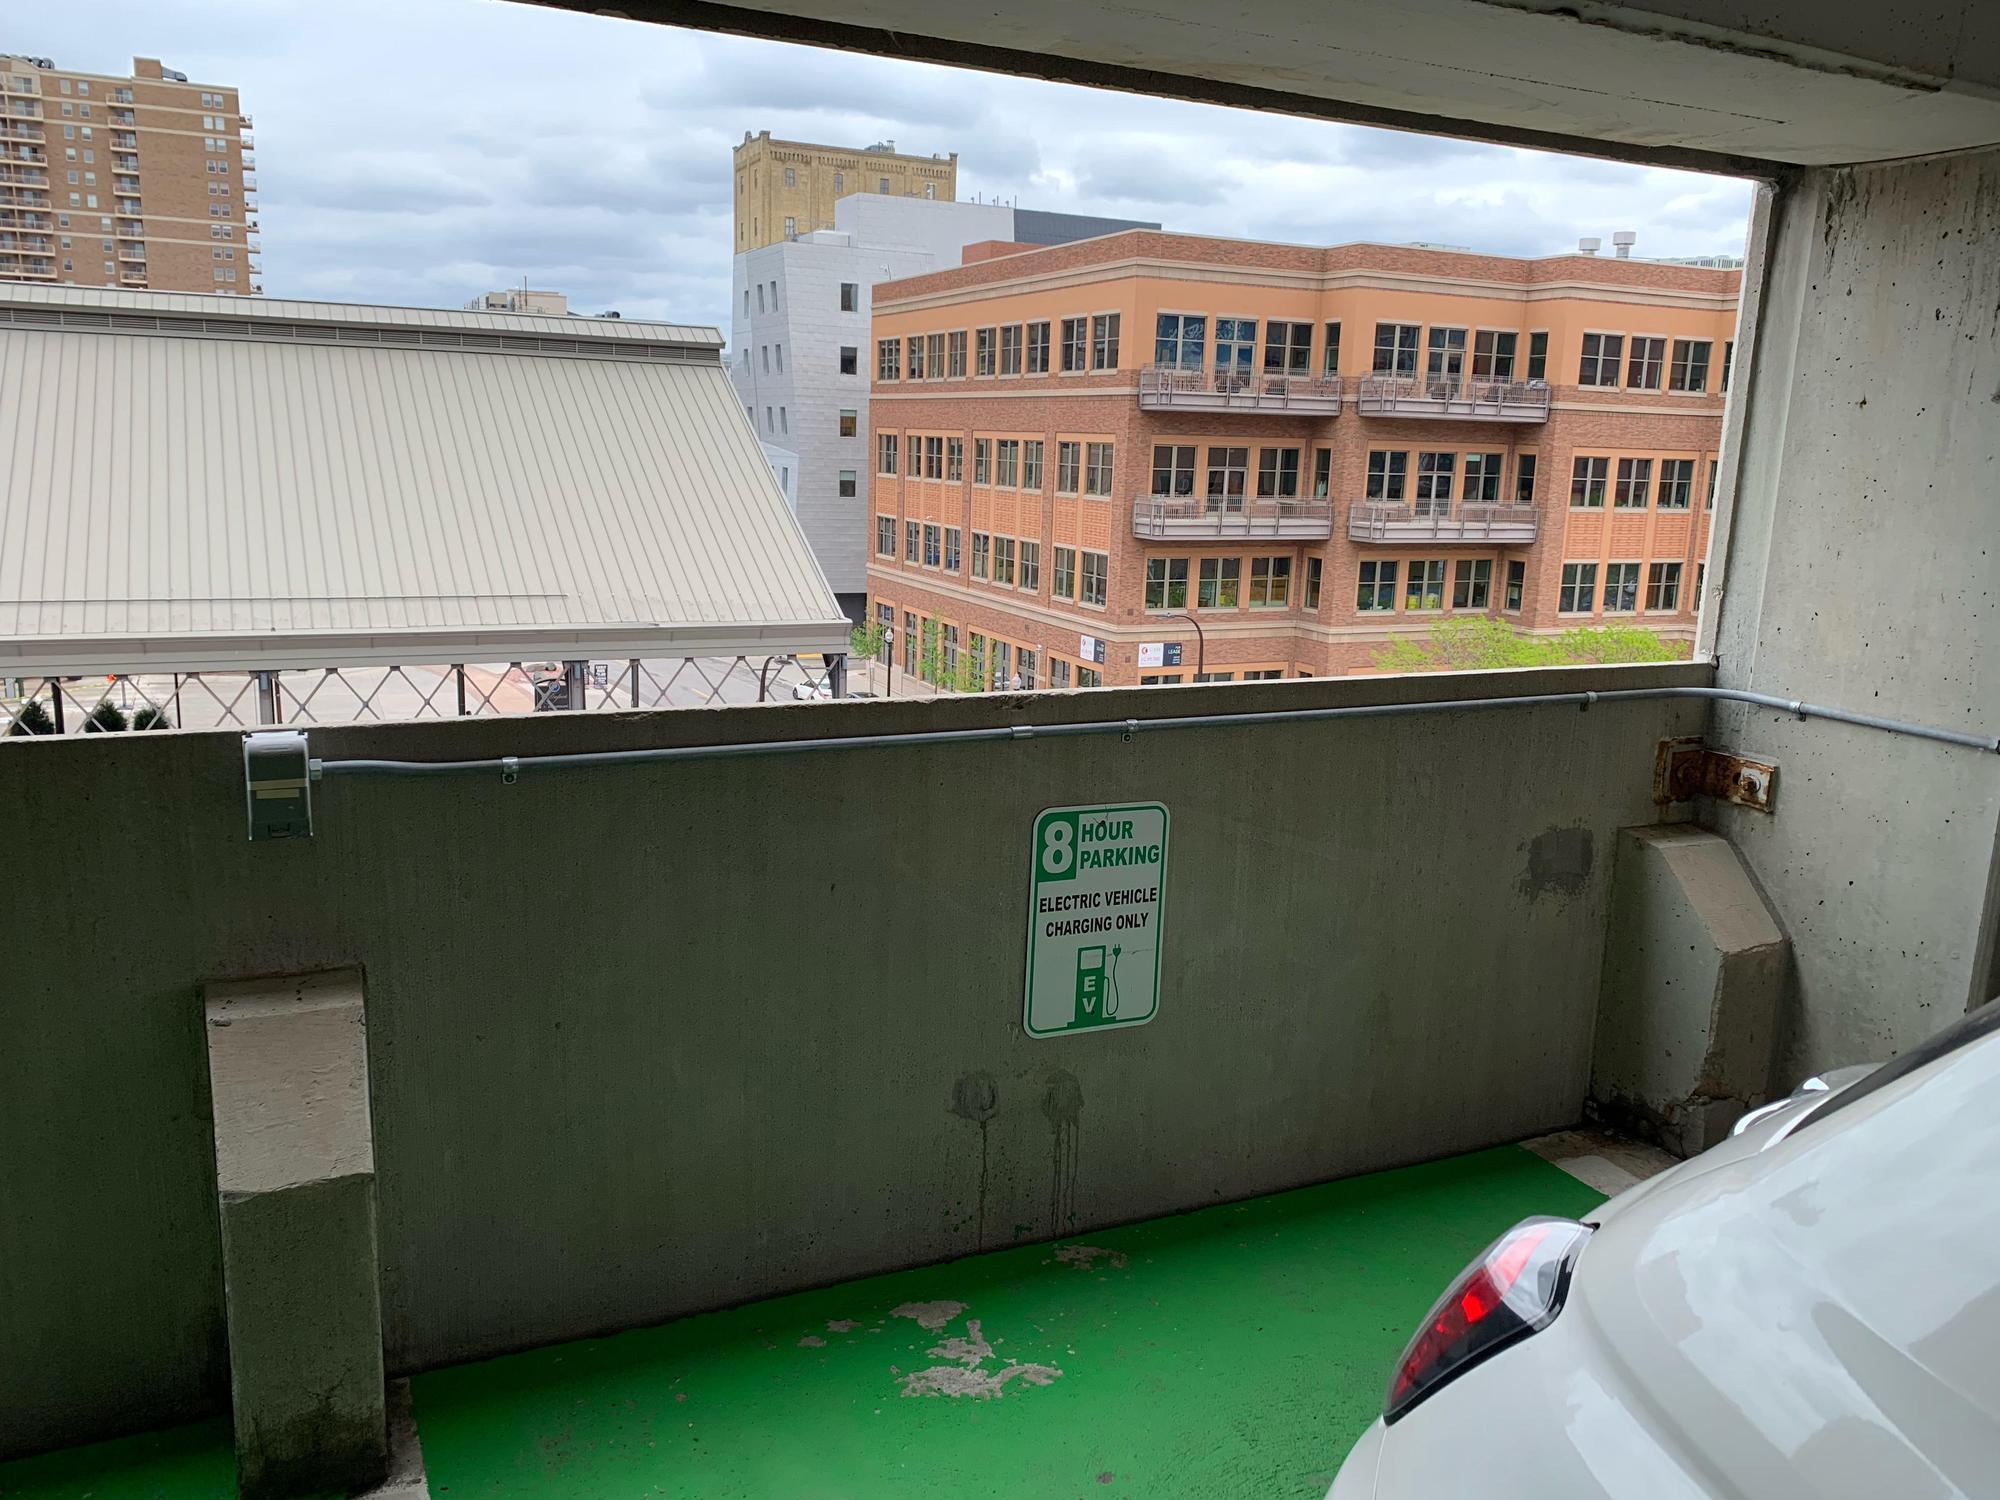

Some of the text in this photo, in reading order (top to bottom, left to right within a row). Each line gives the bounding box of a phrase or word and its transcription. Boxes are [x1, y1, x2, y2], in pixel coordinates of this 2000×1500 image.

[1081, 820, 1133, 843] HOUR
[1042, 820, 1074, 874] 8
[1079, 844, 1160, 870] PARKING
[1039, 887, 1158, 913] ELECTRIC VEHICLE
[1045, 912, 1150, 938] CHARGING ONLY
